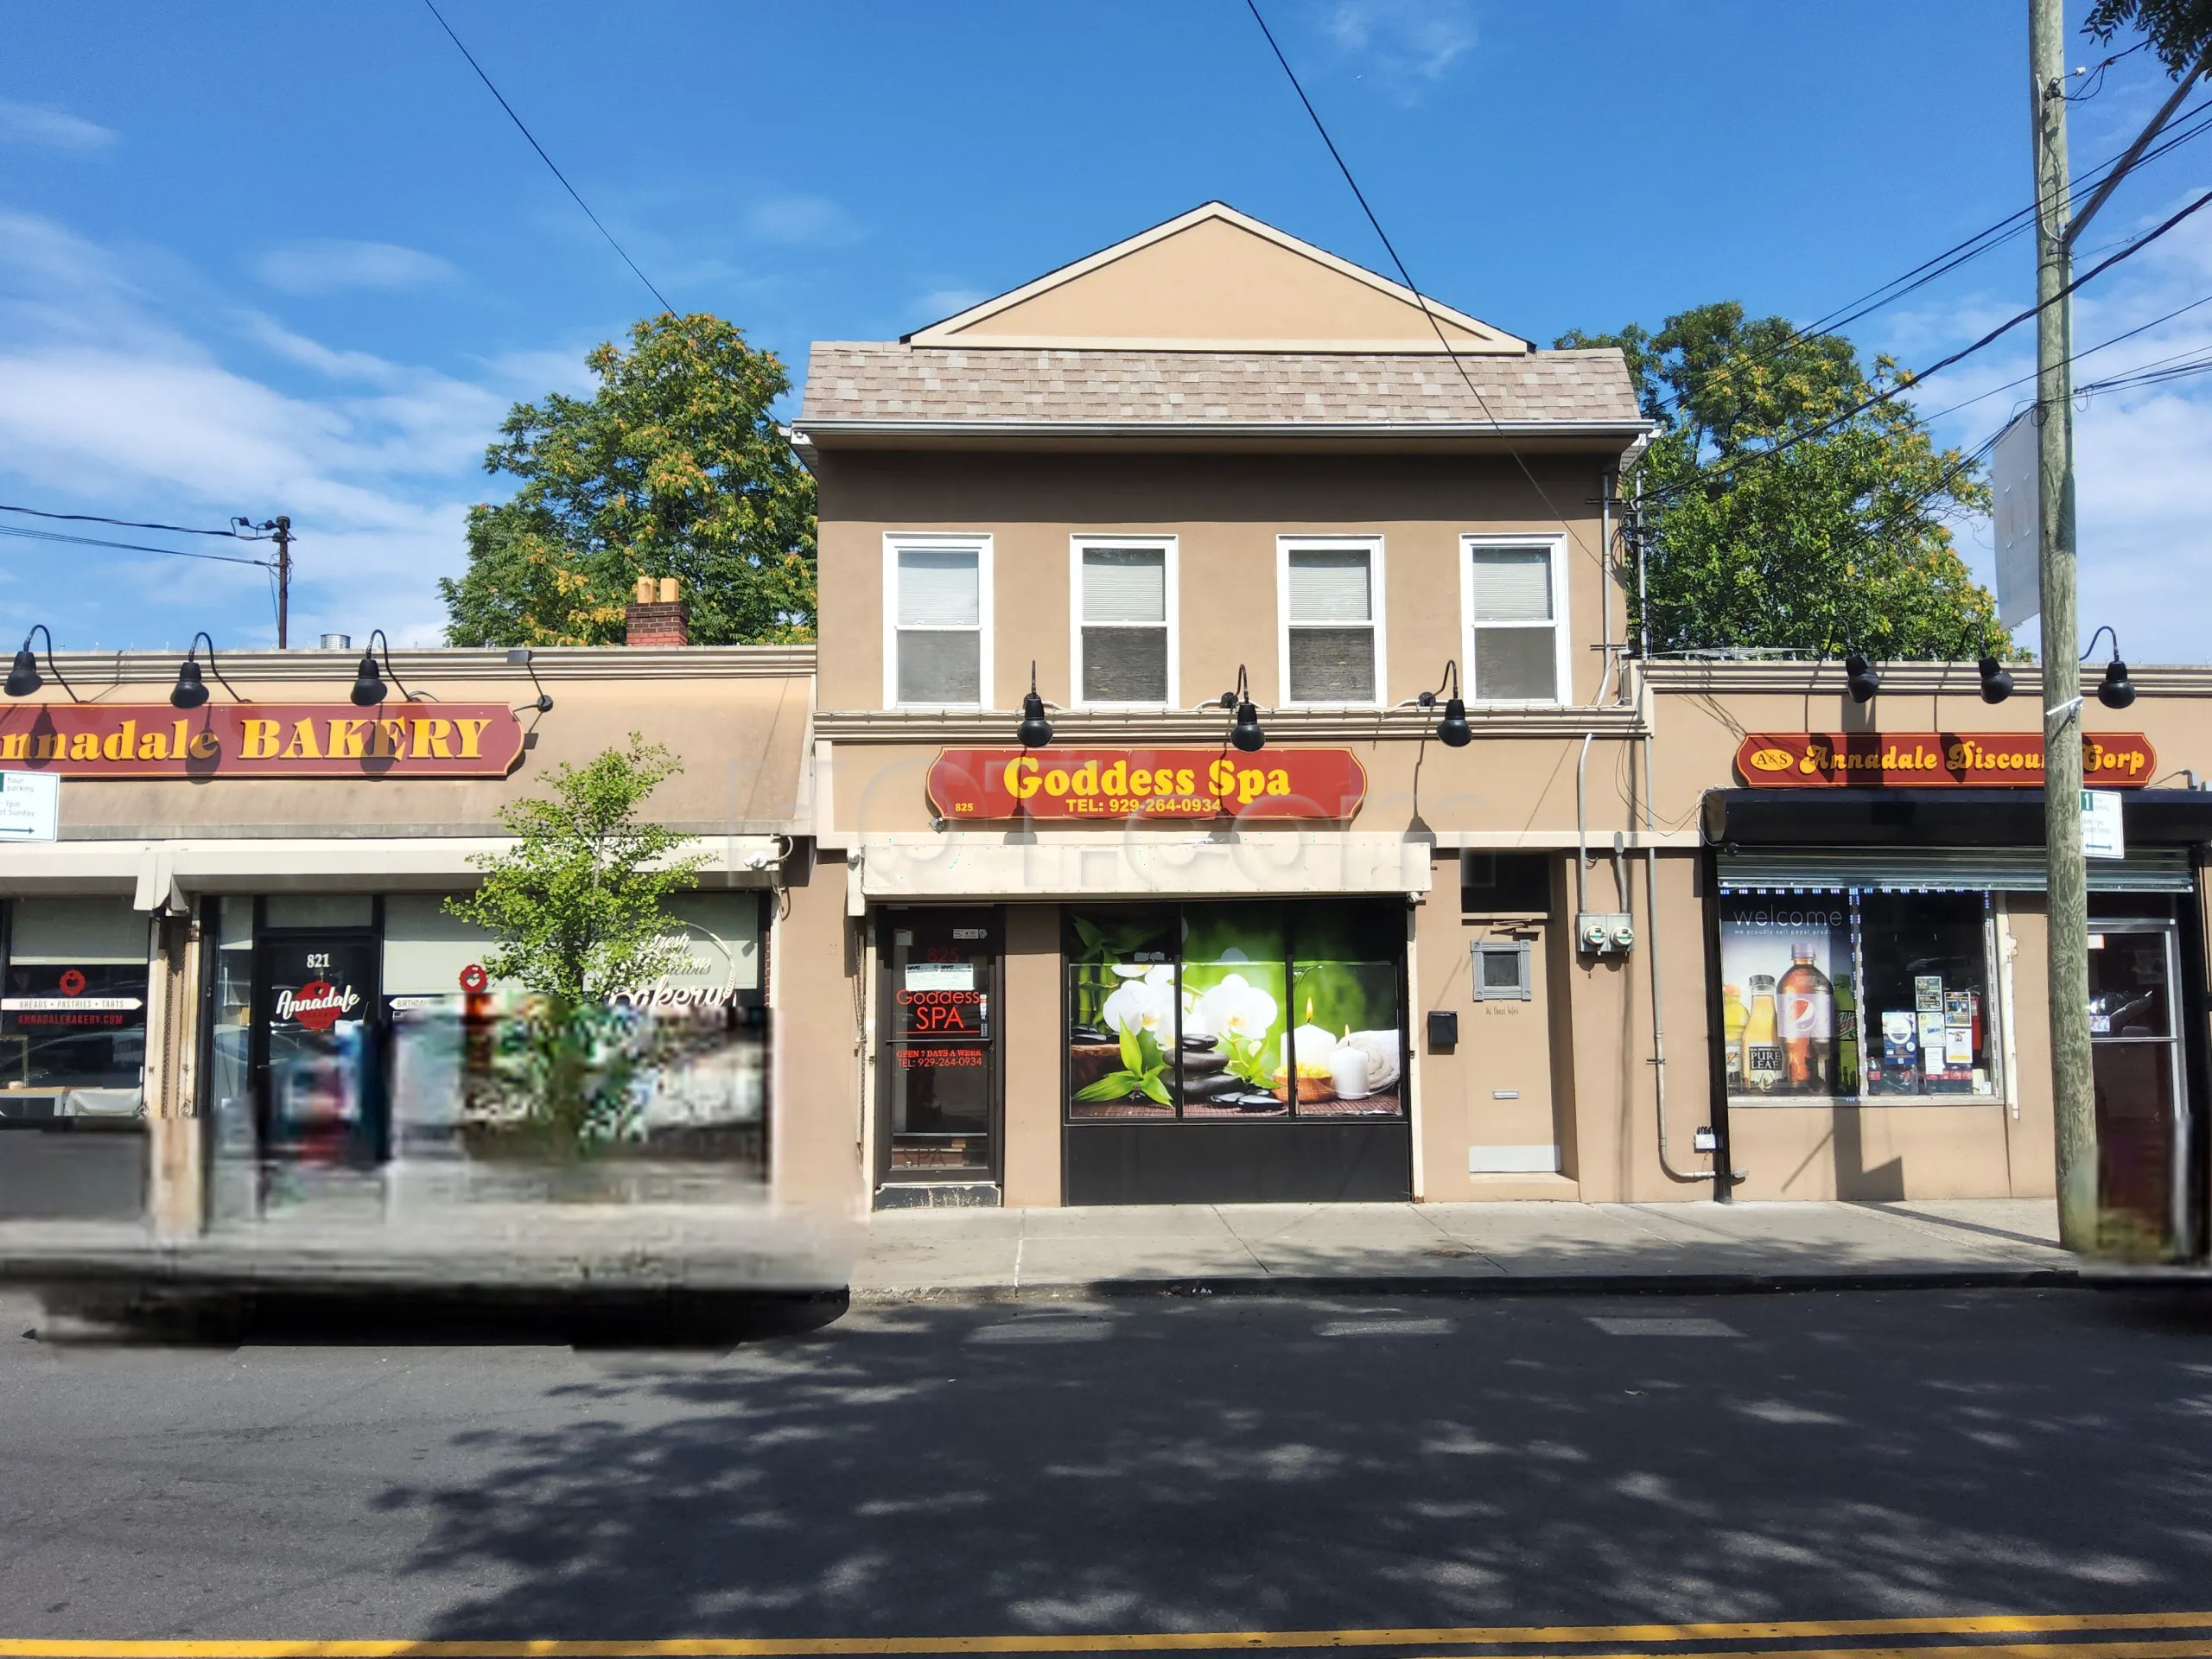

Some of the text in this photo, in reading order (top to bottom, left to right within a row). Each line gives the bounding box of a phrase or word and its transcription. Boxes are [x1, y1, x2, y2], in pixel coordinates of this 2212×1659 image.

[0, 715, 491, 760] nnadale BAKERY
[1757, 741, 2145, 775] A&S Annadale Discou Corp
[1003, 756, 1291, 804] Goddess Spa
[955, 798, 1222, 813] 825 TEL: 929-264-0934
[2083, 793, 2090, 810] 1
[1733, 904, 1842, 926] welcome
[307, 954, 330, 968] 821
[928, 948, 959, 962] 825
[276, 985, 360, 1020] Annadale
[896, 989, 980, 1005] Goddess
[18, 1014, 123, 1025] ANNADALEBAKERY.COM
[916, 1007, 964, 1029] SPA
[899, 1057, 982, 1067] TEL: 929-264-0934
[1751, 1052, 1781, 1060] PURE
